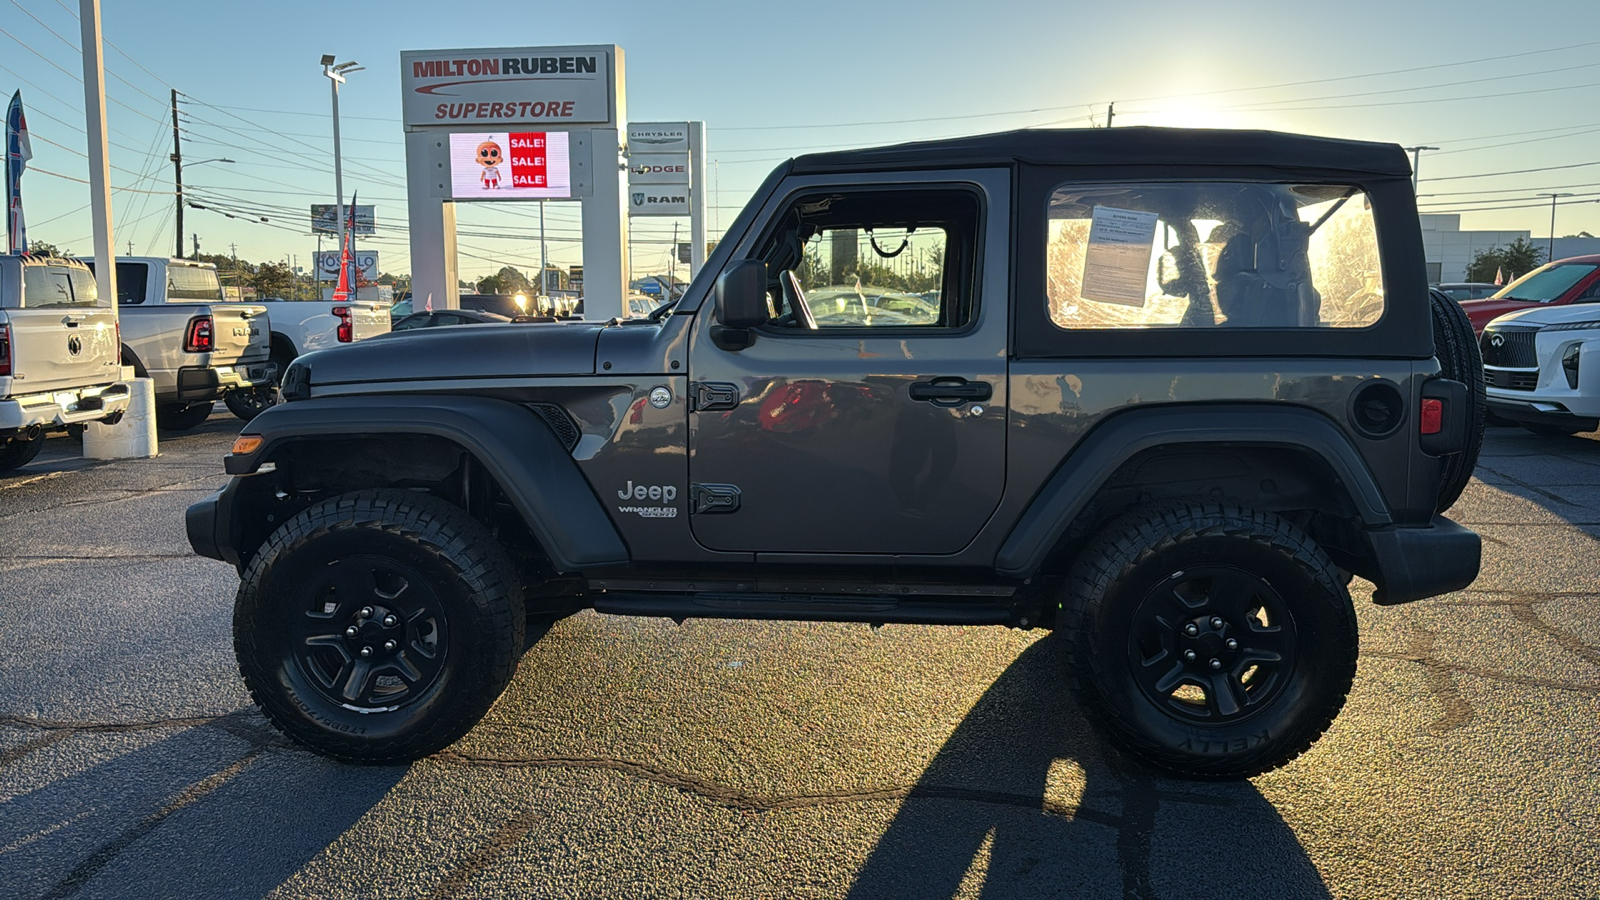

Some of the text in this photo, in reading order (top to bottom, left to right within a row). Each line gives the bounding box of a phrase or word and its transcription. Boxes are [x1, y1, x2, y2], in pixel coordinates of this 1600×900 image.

[413, 56, 597, 78] MILTON RUBEN
[434, 101, 576, 119] SUPERSTORE
[511, 139, 545, 148] SALE!
[512, 157, 545, 167] SALE!
[513, 175, 546, 185] SALE!
[316, 256, 374, 268] HOSLO
[232, 327, 260, 337] RAM
[617, 480, 677, 504] Jeep
[1176, 729, 1271, 753] KELLY
